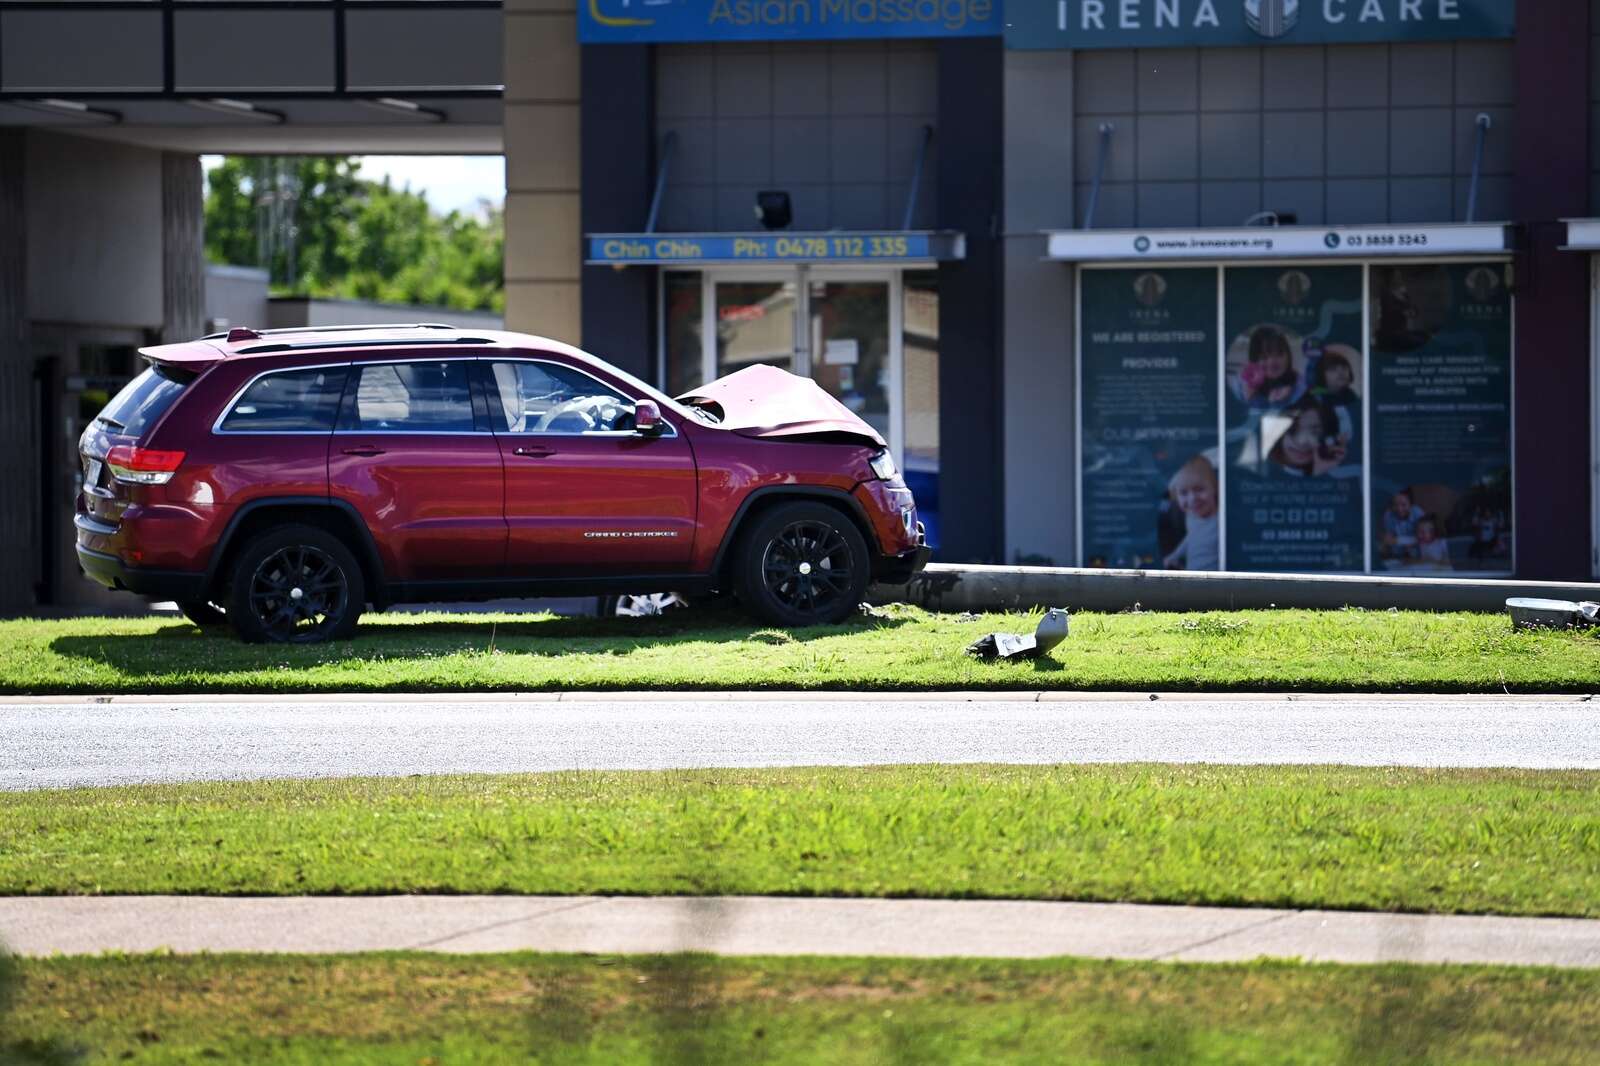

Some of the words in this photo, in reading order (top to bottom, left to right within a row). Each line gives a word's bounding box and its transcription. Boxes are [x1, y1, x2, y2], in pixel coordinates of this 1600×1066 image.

[708, 0, 809, 25] Asian
[818, 0, 992, 29] Massage
[1057, 0, 1220, 30] IRENA
[1322, 0, 1461, 24] CARE
[604, 240, 650, 258] Chin
[655, 240, 702, 258] Chin
[733, 239, 767, 256] Ph:
[775, 238, 828, 256] 0478
[834, 238, 864, 256] 112
[870, 237, 908, 256] 335
[1346, 235, 1362, 247] 03
[1092, 331, 1110, 343] WE
[1112, 331, 1134, 343] ARE
[1136, 330, 1207, 343] REGISTERED
[1122, 357, 1179, 369] PROVIDER
